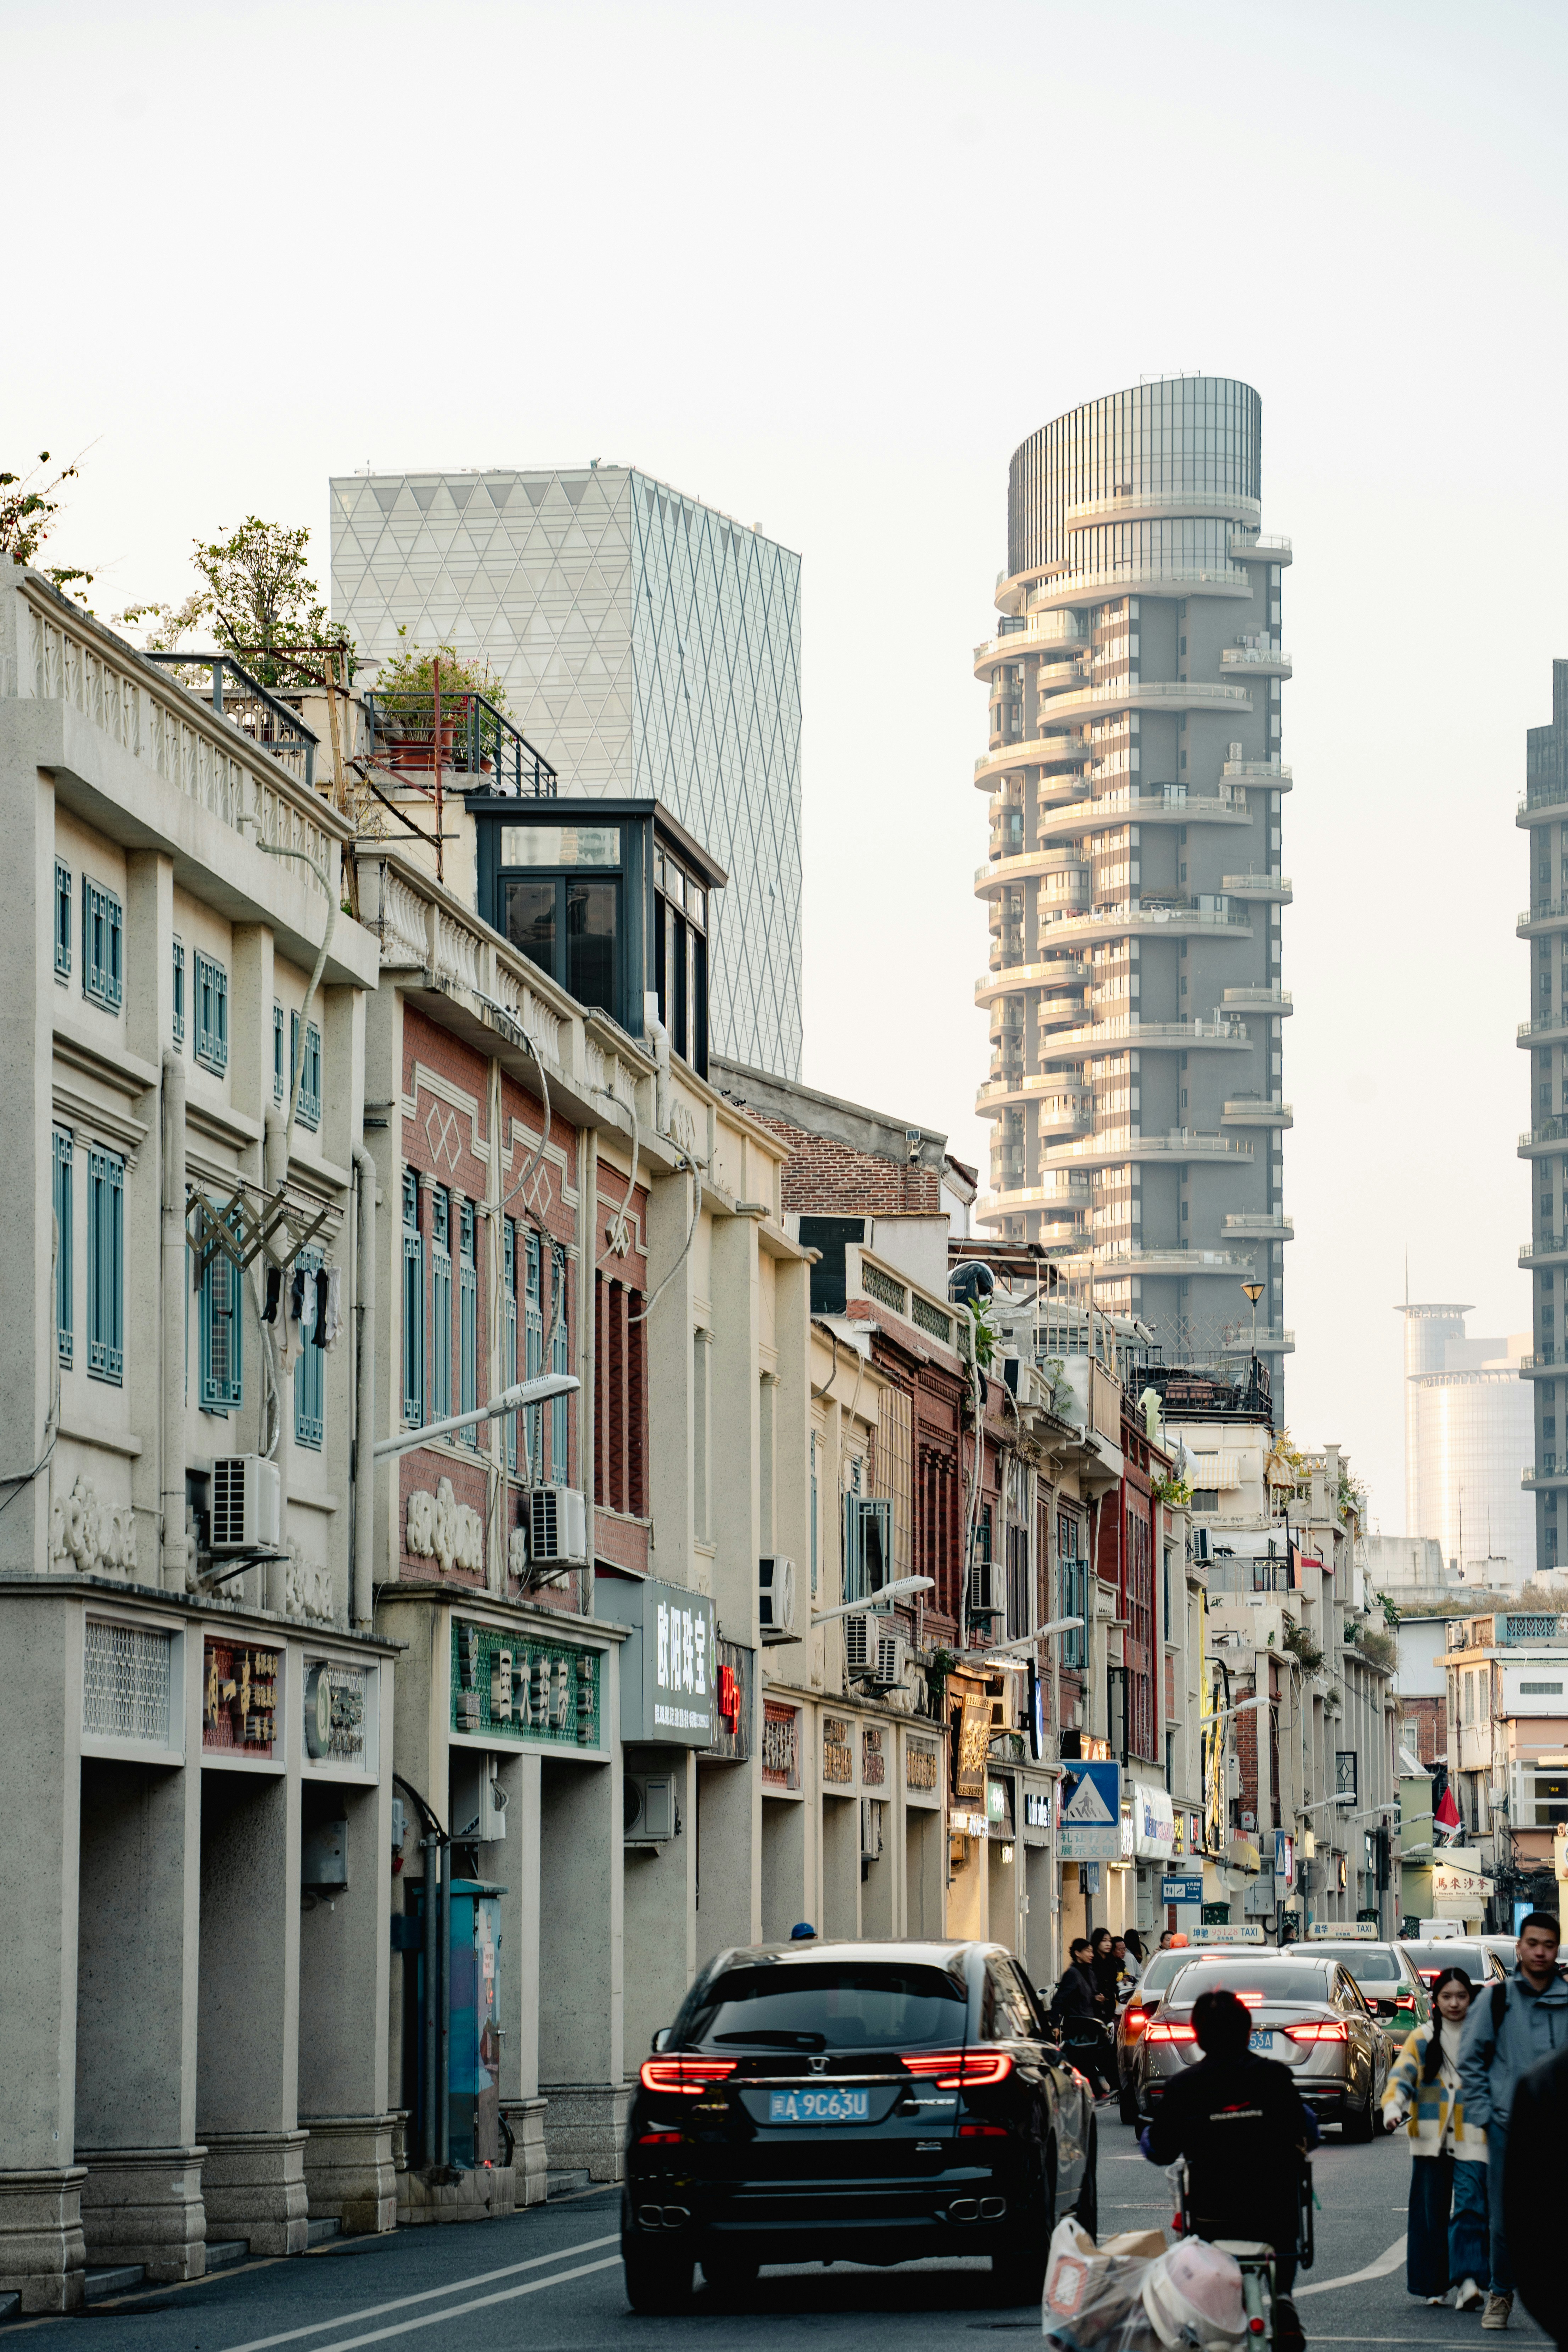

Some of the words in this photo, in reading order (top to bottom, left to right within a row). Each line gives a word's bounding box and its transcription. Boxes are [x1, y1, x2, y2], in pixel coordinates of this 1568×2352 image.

[657, 1600, 705, 1695] 欧阳珠宝
[1061, 1832, 1114, 1843] 礼让行人
[1060, 1845, 1114, 1855] 展示文明
[1193, 1928, 1208, 1938] 坤驰
[1241, 1928, 1257, 1936] TAXI
[1314, 1924, 1328, 1934] 盈华
